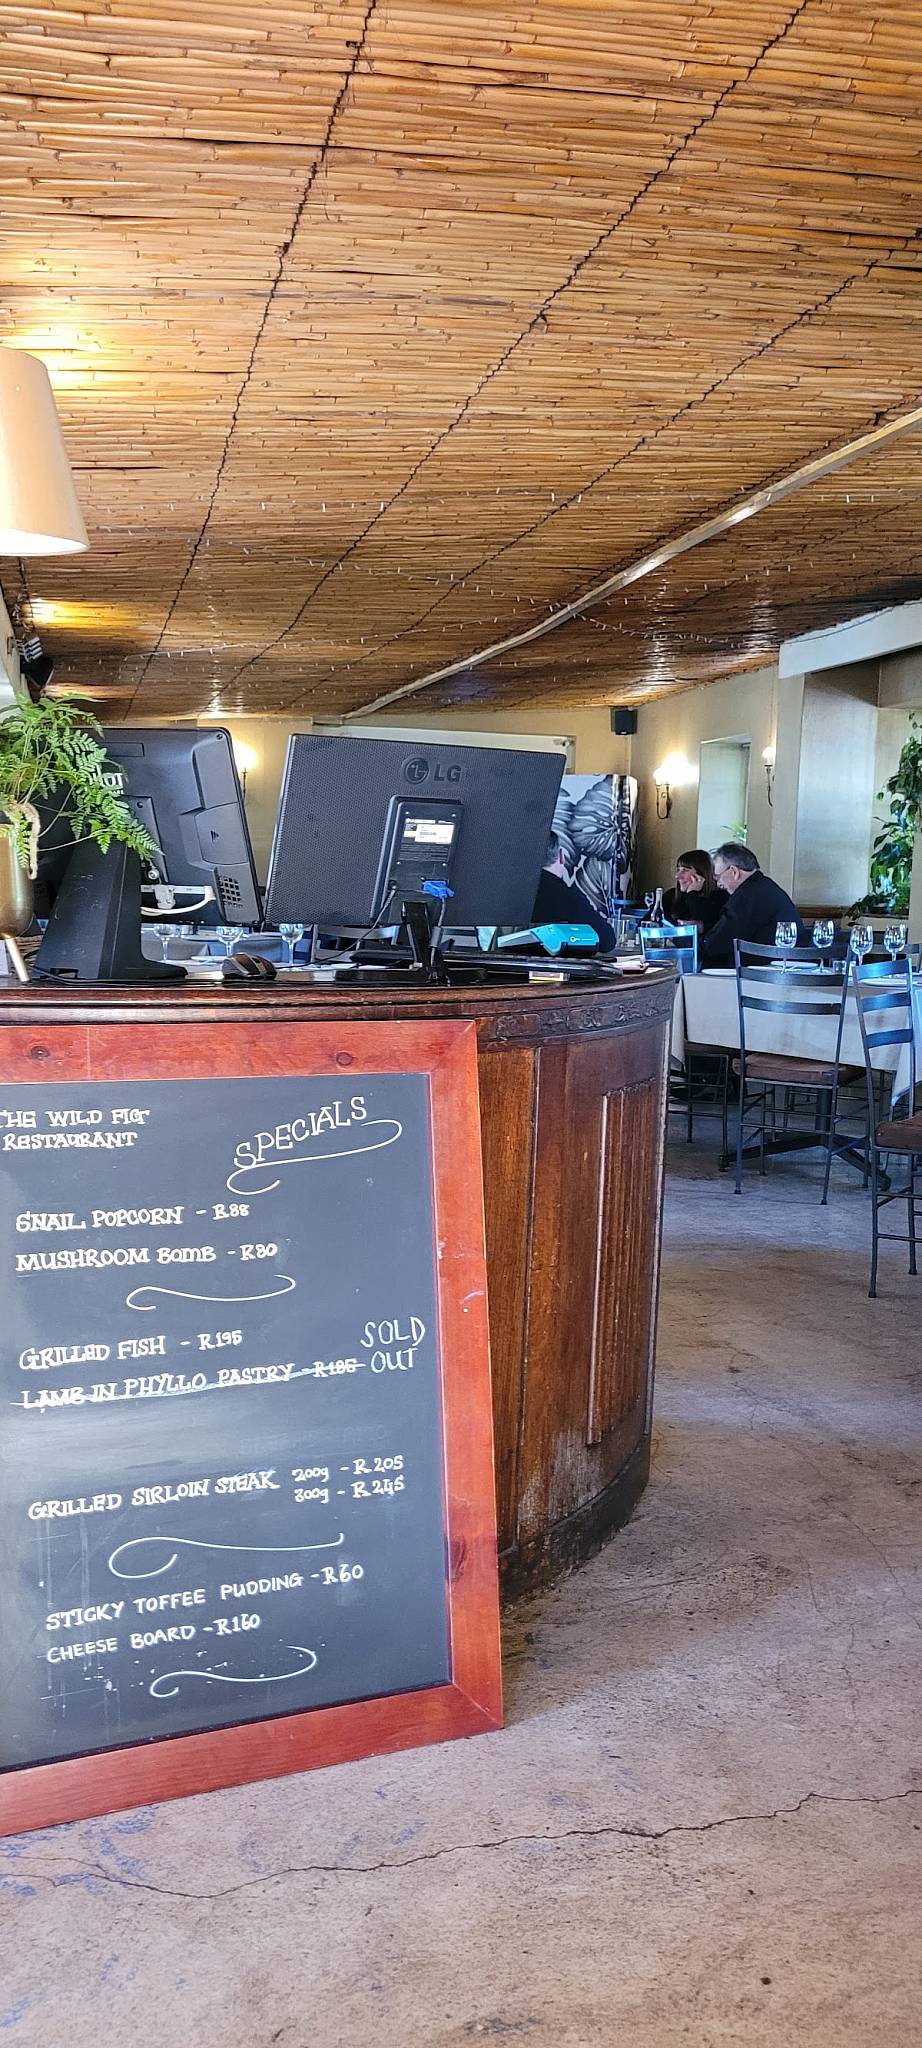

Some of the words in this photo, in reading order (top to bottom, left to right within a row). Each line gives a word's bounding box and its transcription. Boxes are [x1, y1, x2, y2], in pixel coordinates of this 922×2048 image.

[433, 764, 462, 783] LG
[44, 1109, 103, 1128] WILD
[233, 1096, 368, 1170] SPECIALS
[2, 1131, 138, 1151] RESTAURANT
[15, 1210, 87, 1233] SNAIL
[91, 1205, 185, 1228] POPCORN
[15, 1247, 151, 1272] MUSHROOM
[359, 1316, 426, 1350] SOLD
[18, 1343, 111, 1370] GRILLED
[116, 1335, 166, 1360] FISH
[370, 1347, 418, 1374] OUT
[20, 1384, 86, 1410] LAMB
[90, 1381, 117, 1402] IN
[122, 1371, 208, 1399] PHYLLO
[216, 1361, 297, 1390] PASTRY
[27, 1493, 123, 1521] GRILLED
[131, 1478, 211, 1506] SIRLOIN
[214, 1469, 281, 1494] STEAK
[291, 1466, 330, 1483] 200g
[294, 1487, 330, 1504] 300g
[45, 1600, 125, 1631] STICKY
[132, 1588, 206, 1614] TOFFEE
[220, 1572, 304, 1600] PUDDING
[46, 1637, 118, 1664] CHEESE
[129, 1625, 196, 1649] BOARD
